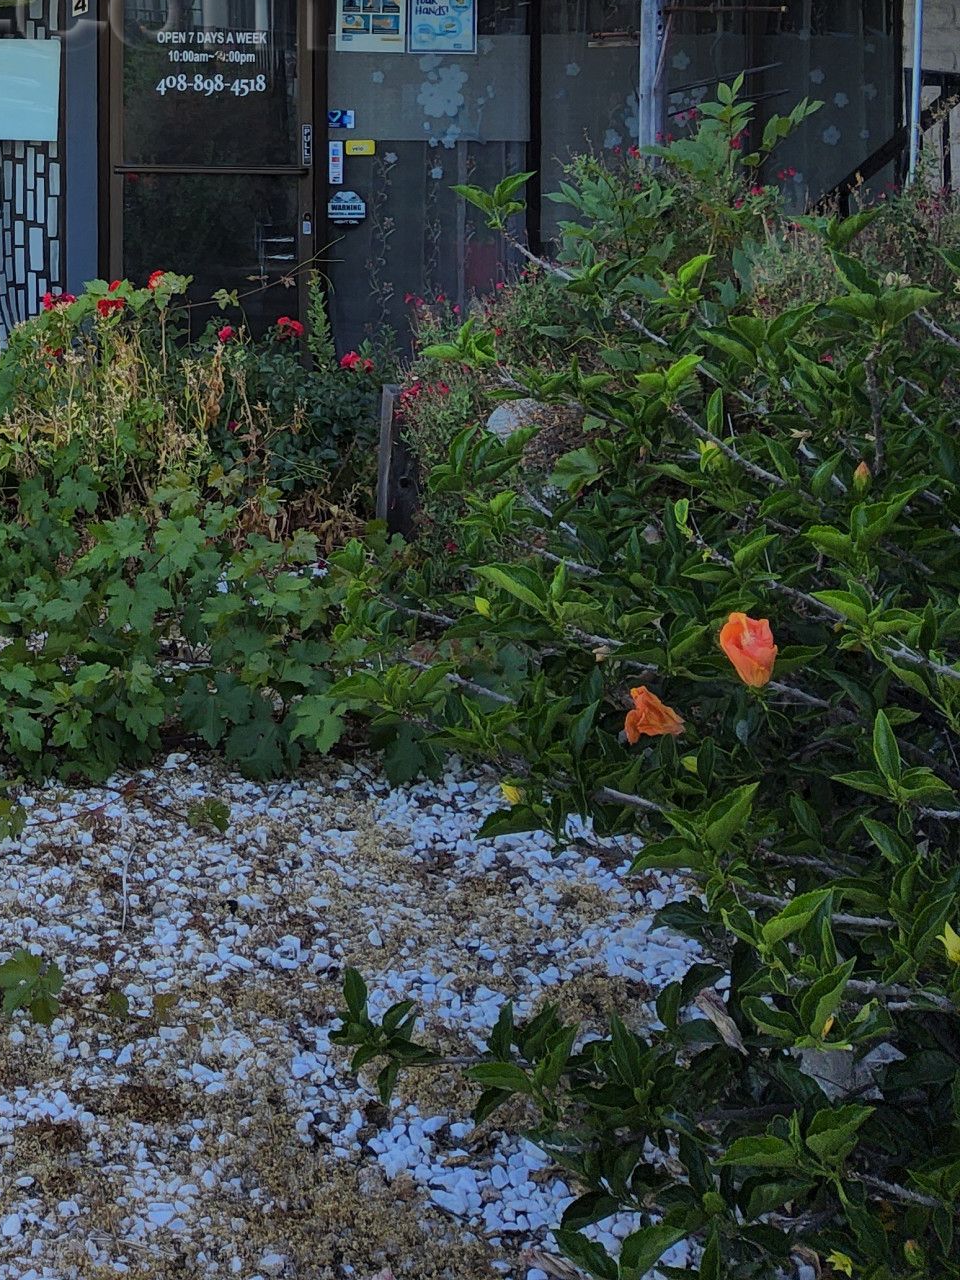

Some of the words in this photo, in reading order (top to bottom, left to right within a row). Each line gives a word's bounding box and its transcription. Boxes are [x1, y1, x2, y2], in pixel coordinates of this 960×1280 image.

[157, 32, 186, 44] OPEN
[188, 32, 195, 44] 7
[197, 32, 225, 44] DAYS
[226, 32, 234, 44] A
[236, 32, 268, 44] WEEK
[156, 73, 267, 97] 408-898-4518
[303, 128, 311, 156] PULL
